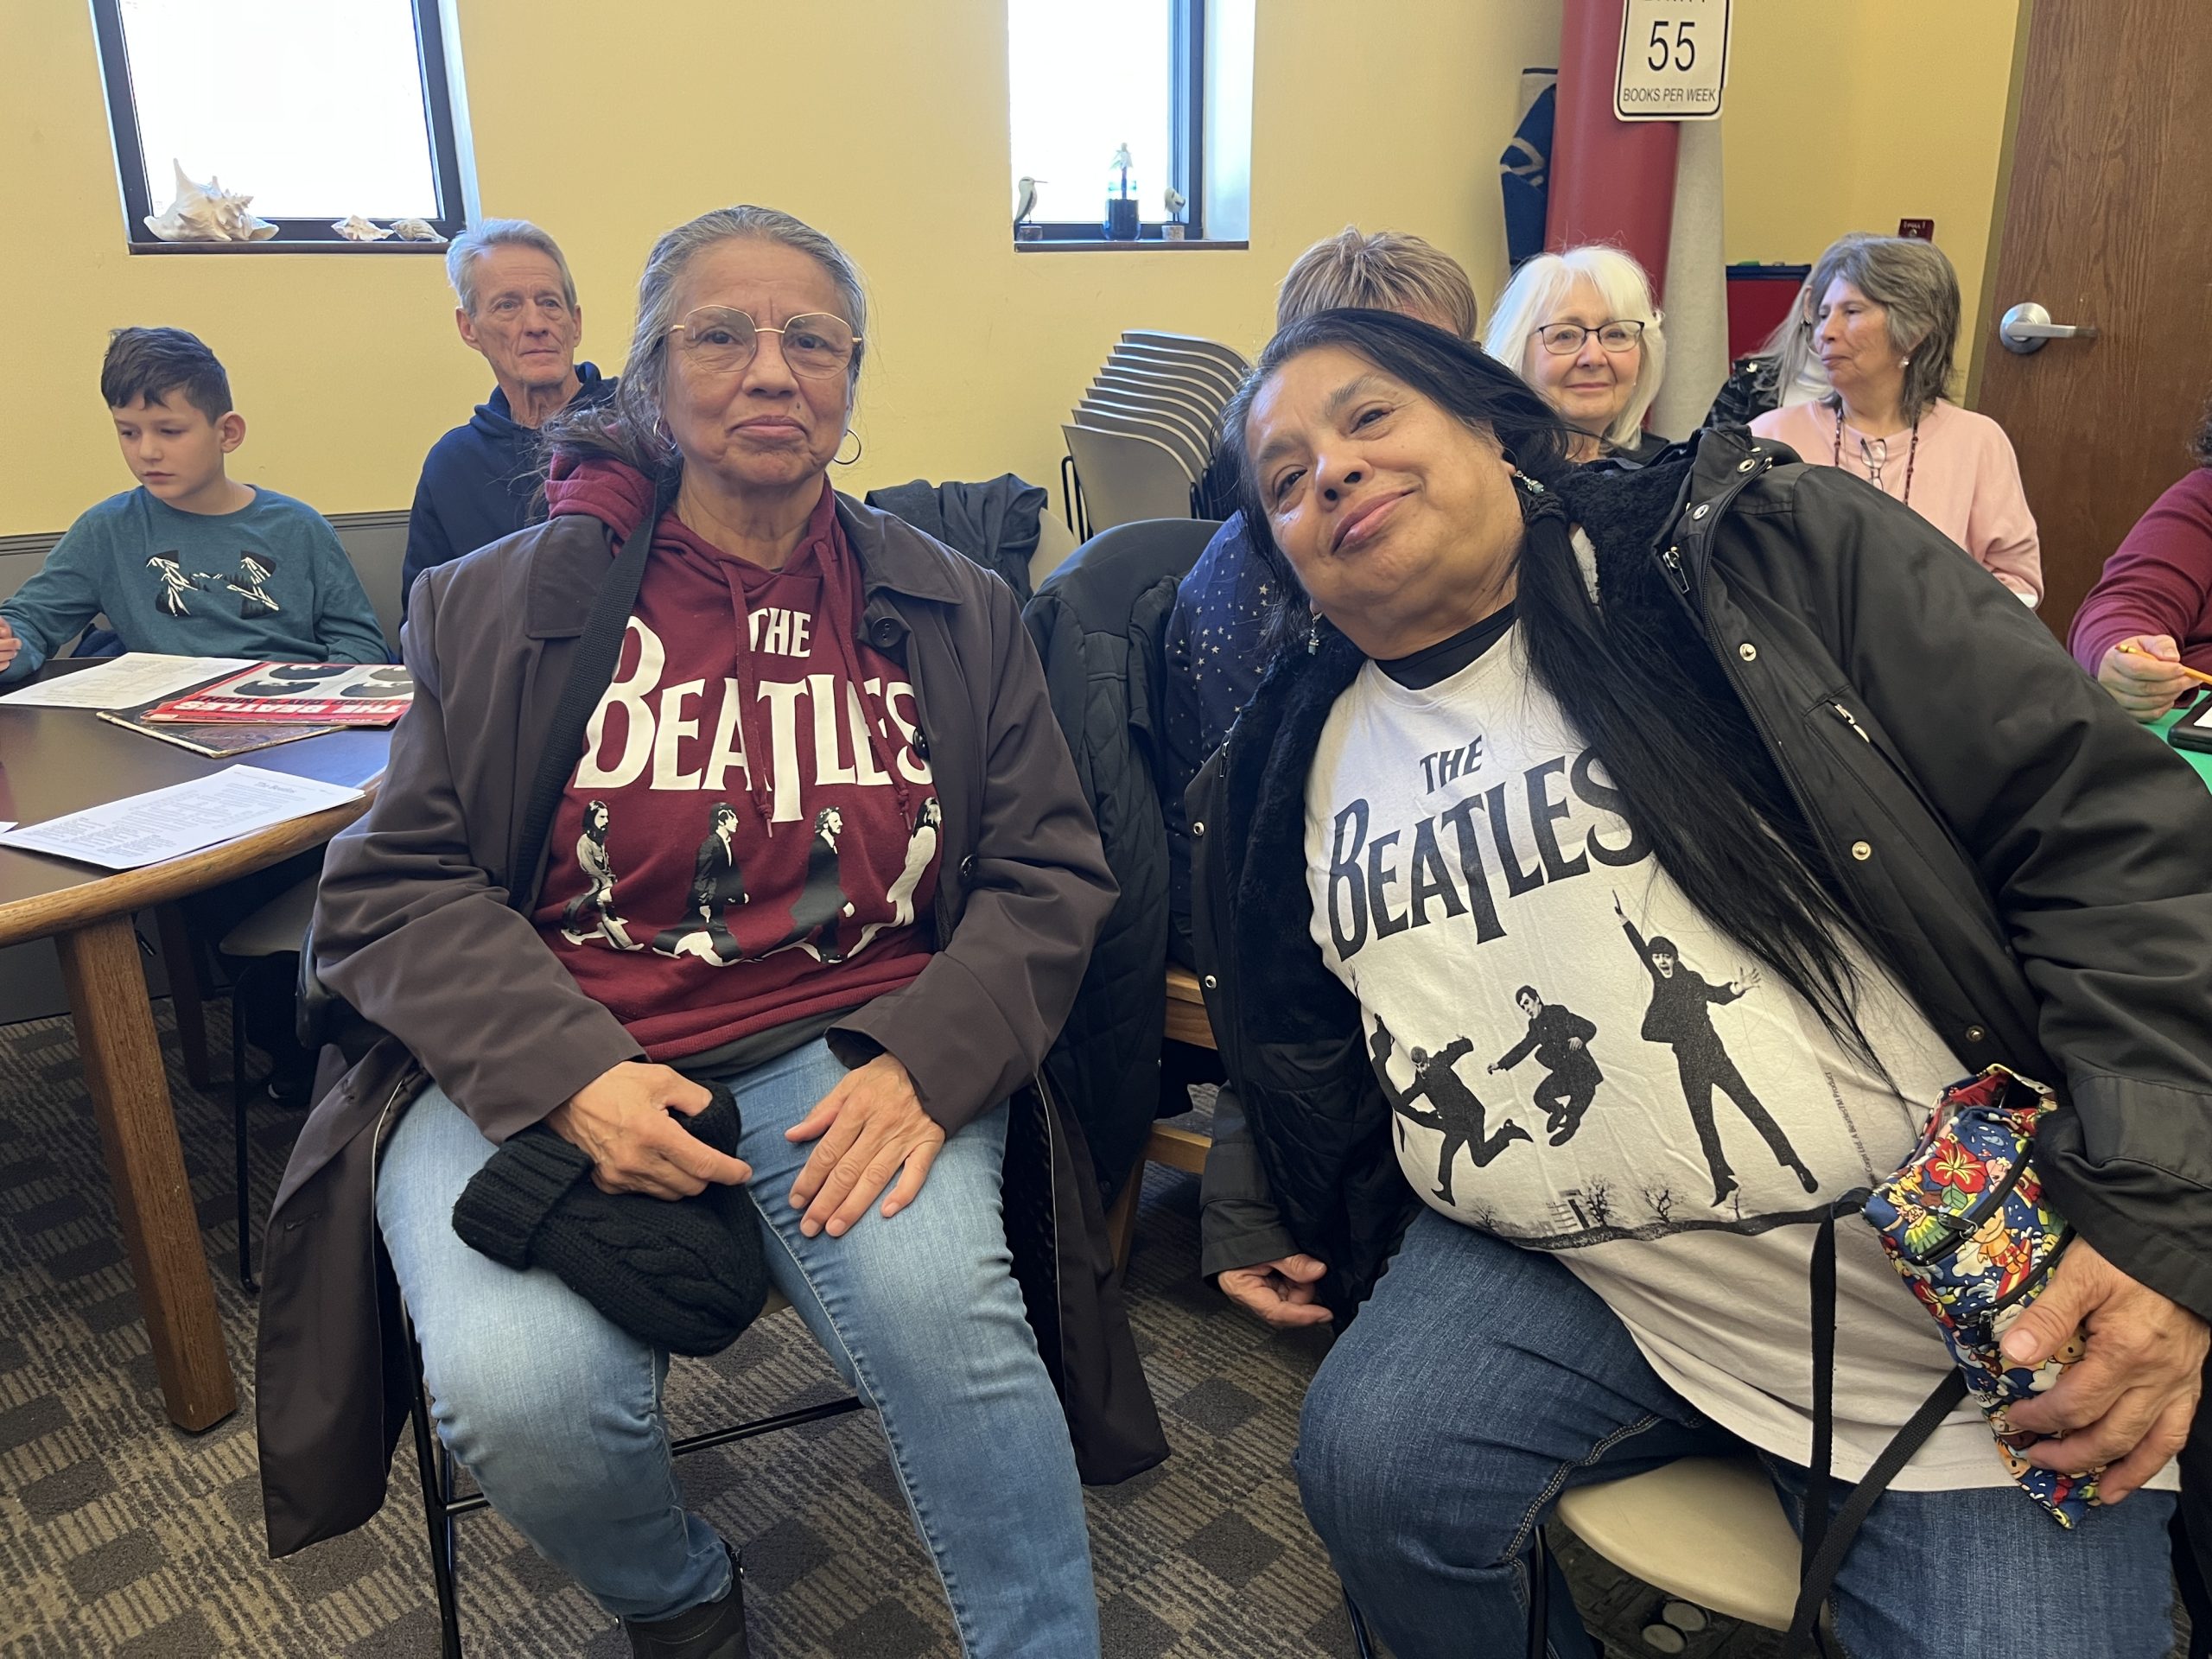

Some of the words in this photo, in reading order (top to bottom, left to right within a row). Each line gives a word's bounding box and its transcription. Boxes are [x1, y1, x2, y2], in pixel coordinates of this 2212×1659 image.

[1648, 21, 1695, 71] 55
[1623, 87, 1661, 102] BOOKS
[1662, 87, 1684, 102] PER
[1686, 87, 1716, 102] WEEK
[748, 607, 811, 658] THE
[174, 701, 330, 714] BEATLES
[333, 704, 403, 714] THE
[574, 615, 933, 823] BEATLES
[1420, 735, 1484, 795] THE
[1328, 746, 1654, 962] BEATLES
[1825, 1071, 1840, 1098] Product
